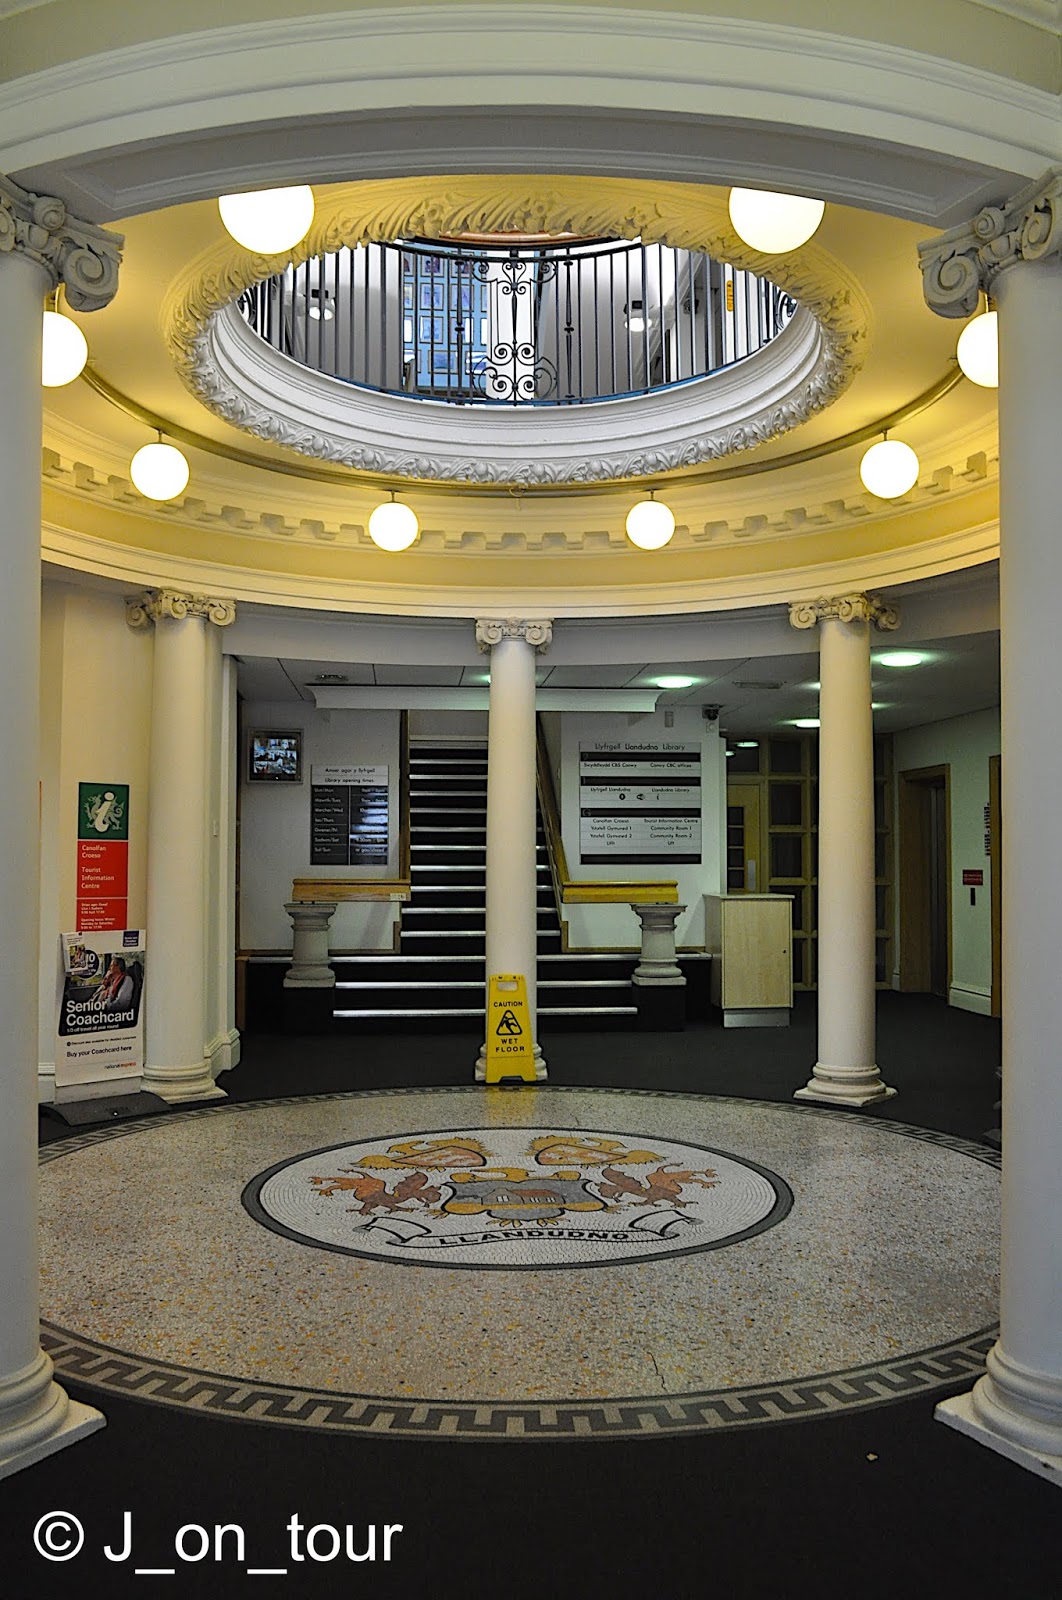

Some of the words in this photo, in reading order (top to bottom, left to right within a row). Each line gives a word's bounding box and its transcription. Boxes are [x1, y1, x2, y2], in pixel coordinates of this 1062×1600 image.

[66, 1000, 107, 1013] Senior
[66, 1008, 134, 1026] Coachcard
[91, 1046, 120, 1054] Coachcard
[440, 1230, 629, 1245] LLANDUDNO
